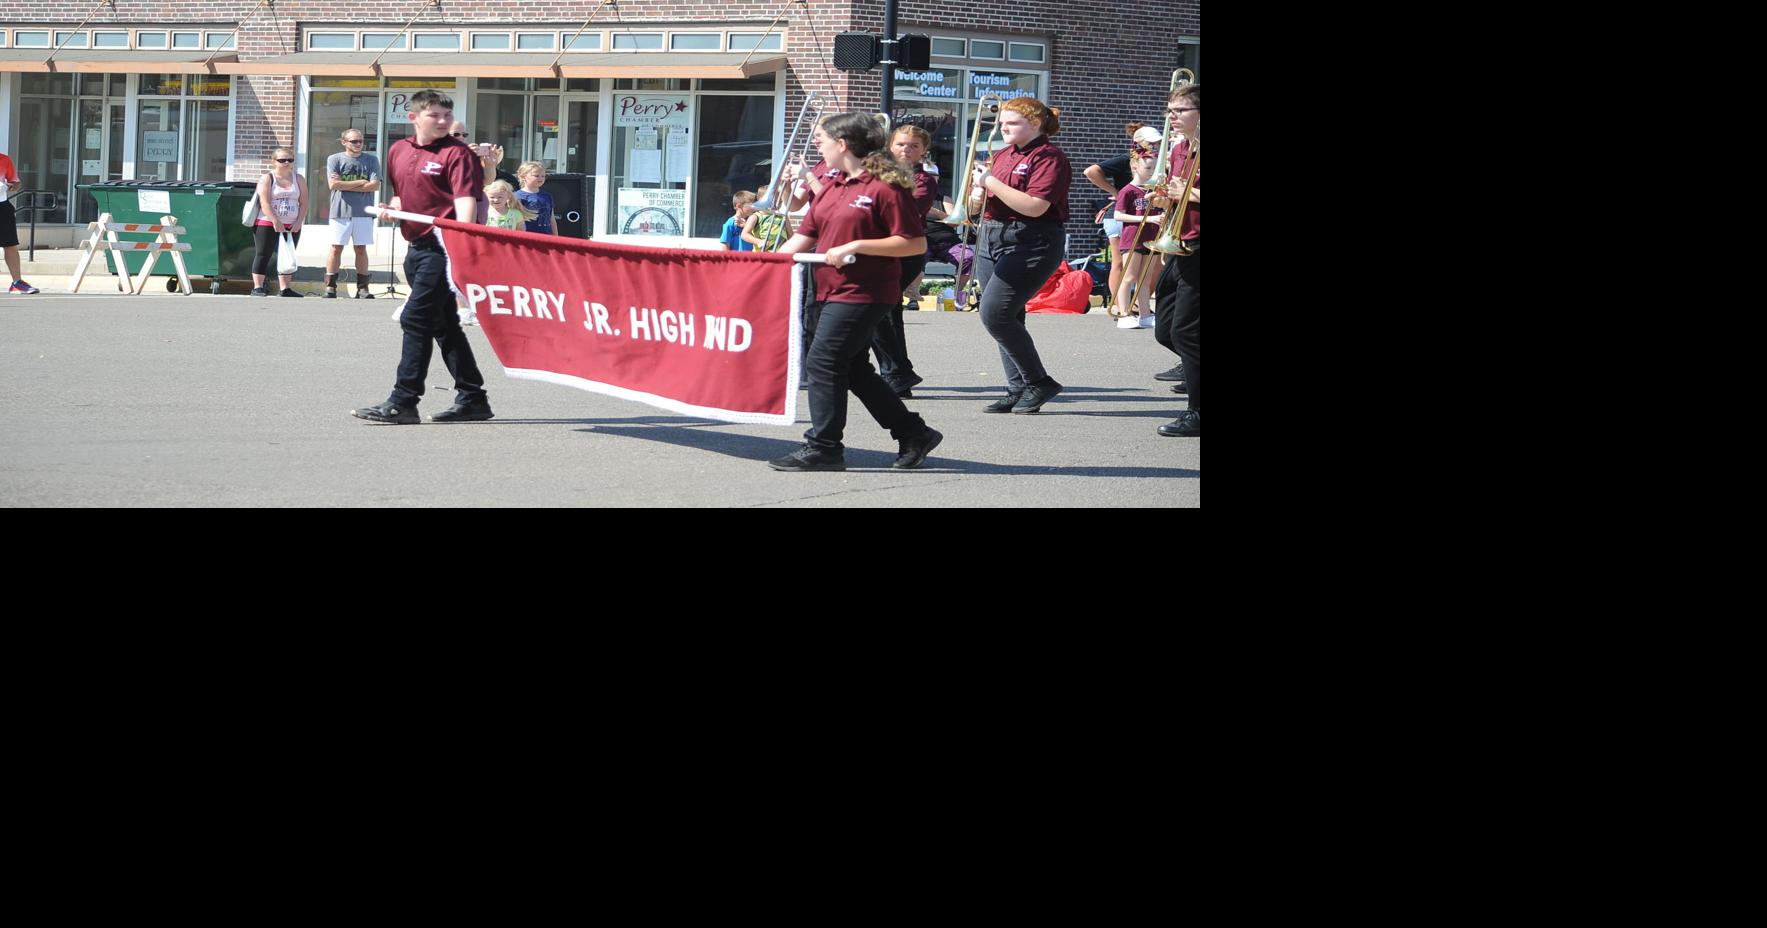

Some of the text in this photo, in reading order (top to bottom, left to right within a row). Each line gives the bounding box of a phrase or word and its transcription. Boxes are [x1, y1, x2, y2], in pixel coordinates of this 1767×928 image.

[894, 70, 943, 82] Welcome
[970, 73, 1009, 86] Tourism
[920, 83, 957, 97] Center
[974, 86, 1036, 99] Information
[620, 96, 673, 119] Perry
[643, 191, 659, 199] PERRY
[466, 283, 566, 322] PERRY
[583, 300, 621, 336] JR.
[629, 306, 695, 347] HIGH
